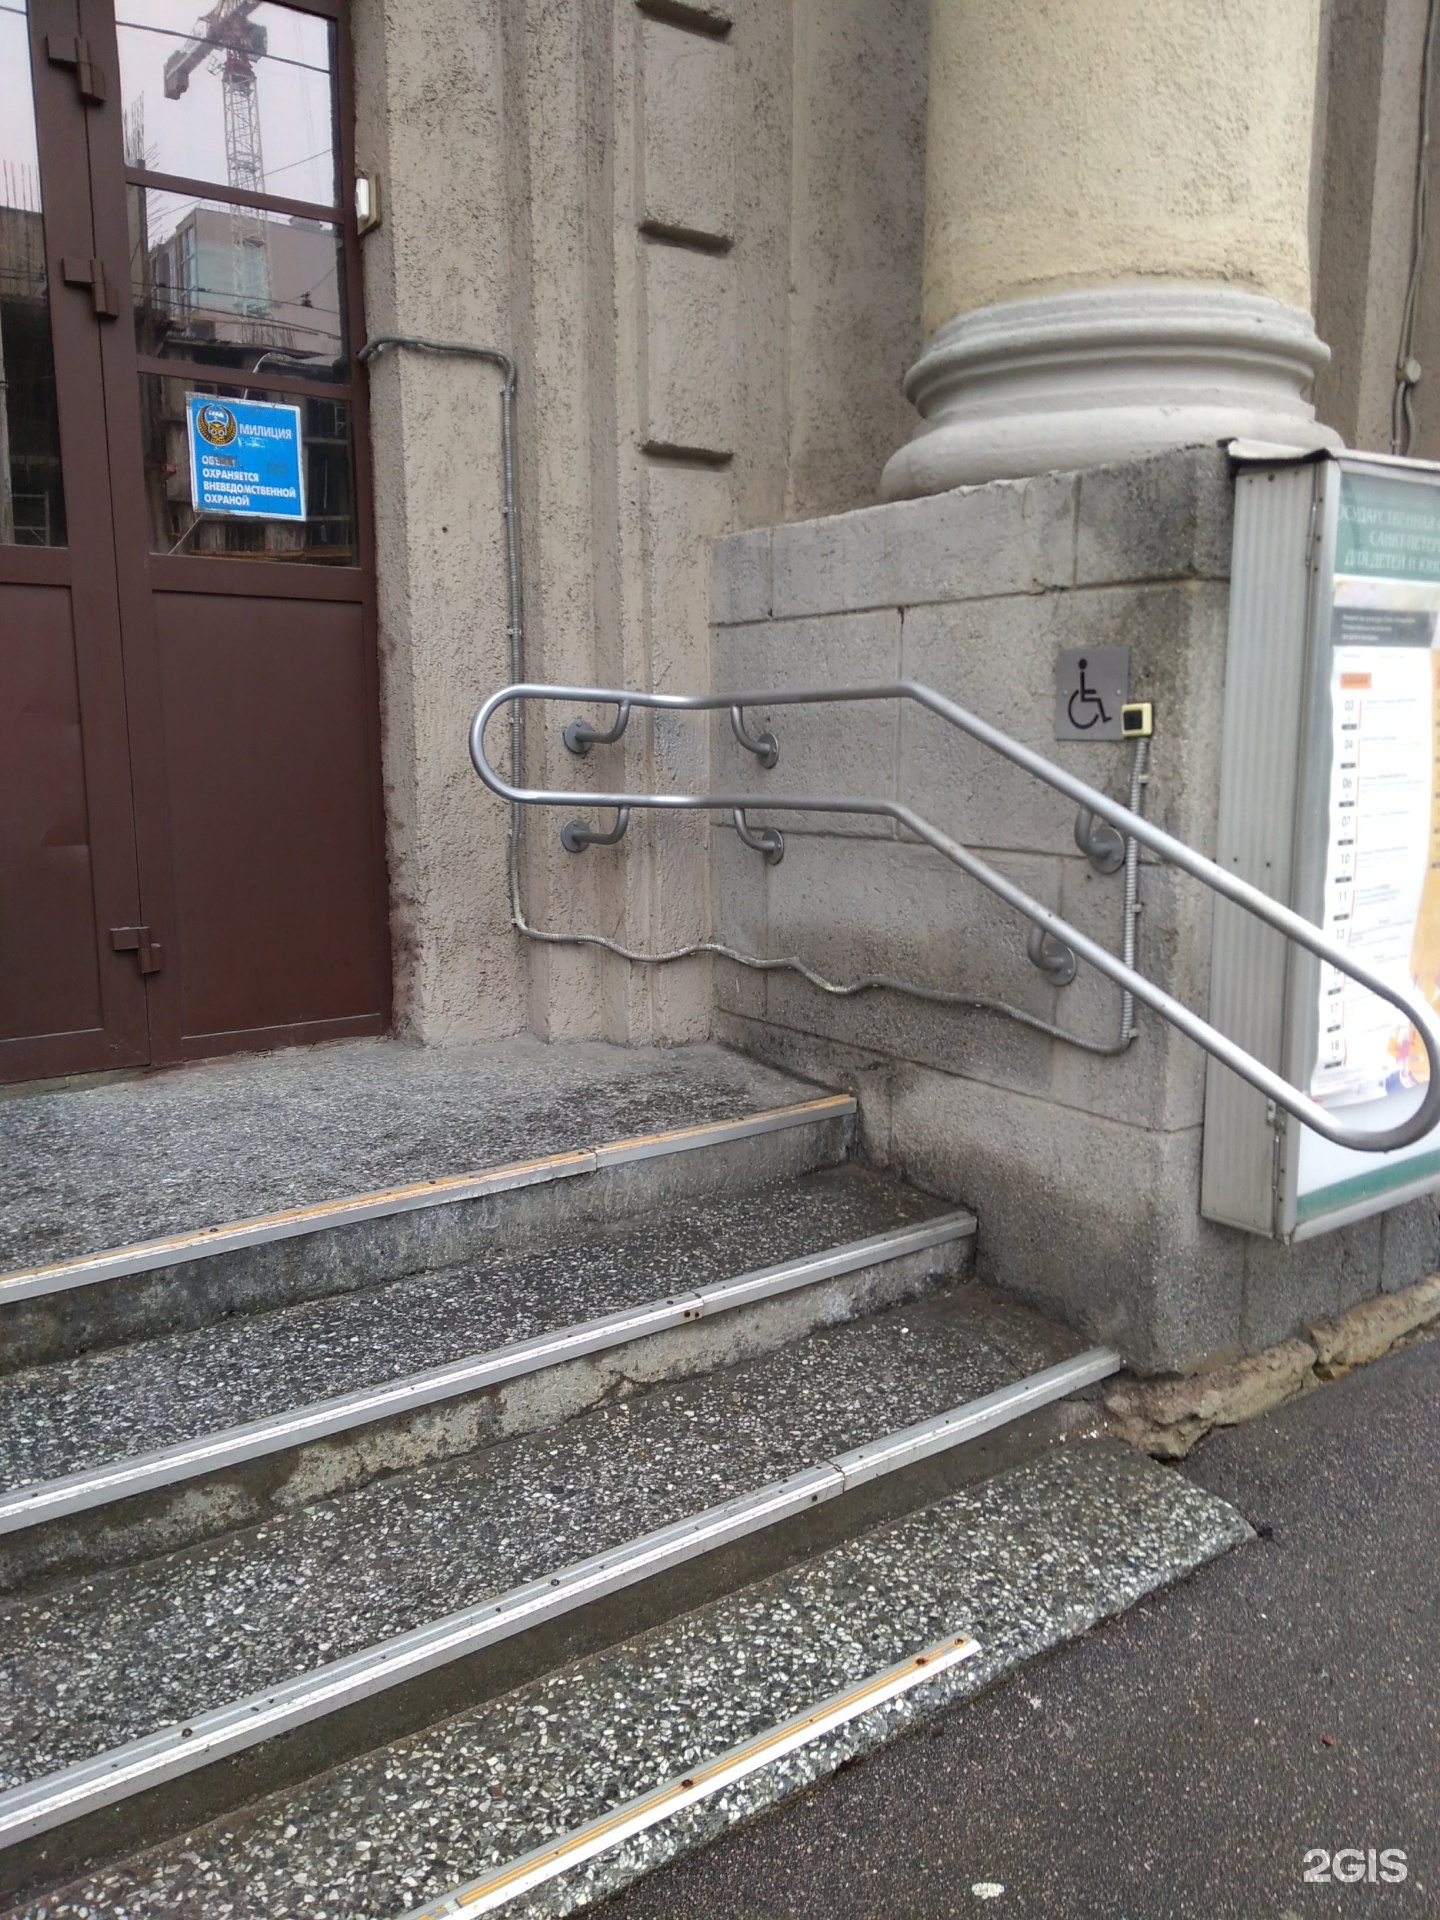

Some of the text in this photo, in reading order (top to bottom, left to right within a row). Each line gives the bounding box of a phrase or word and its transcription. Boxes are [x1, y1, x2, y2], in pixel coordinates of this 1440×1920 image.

[240, 424, 292, 440] МИЛИЦИЯ
[202, 455, 236, 467] ОБЪТ
[202, 468, 259, 482] ОХРАНЯЕТСЯ
[203, 481, 296, 498] ВНЕВЕДОМСТВЕННОЙ
[204, 494, 250, 506] ОХРАНОЙ
[1338, 506, 1435, 531] ОСУДАРСТВЕННАЯ
[1369, 530, 1440, 552] САНКТ-ПЕТЕР
[1344, 700, 1355, 711] 03
[1344, 739, 1354, 750] 04
[1342, 777, 1353, 789] 06
[1341, 815, 1351, 827] 07
[1341, 853, 1350, 864] 10
[1339, 891, 1347, 902] 11
[1336, 928, 1345, 940] 13
[1330, 1039, 1340, 1051] 18
